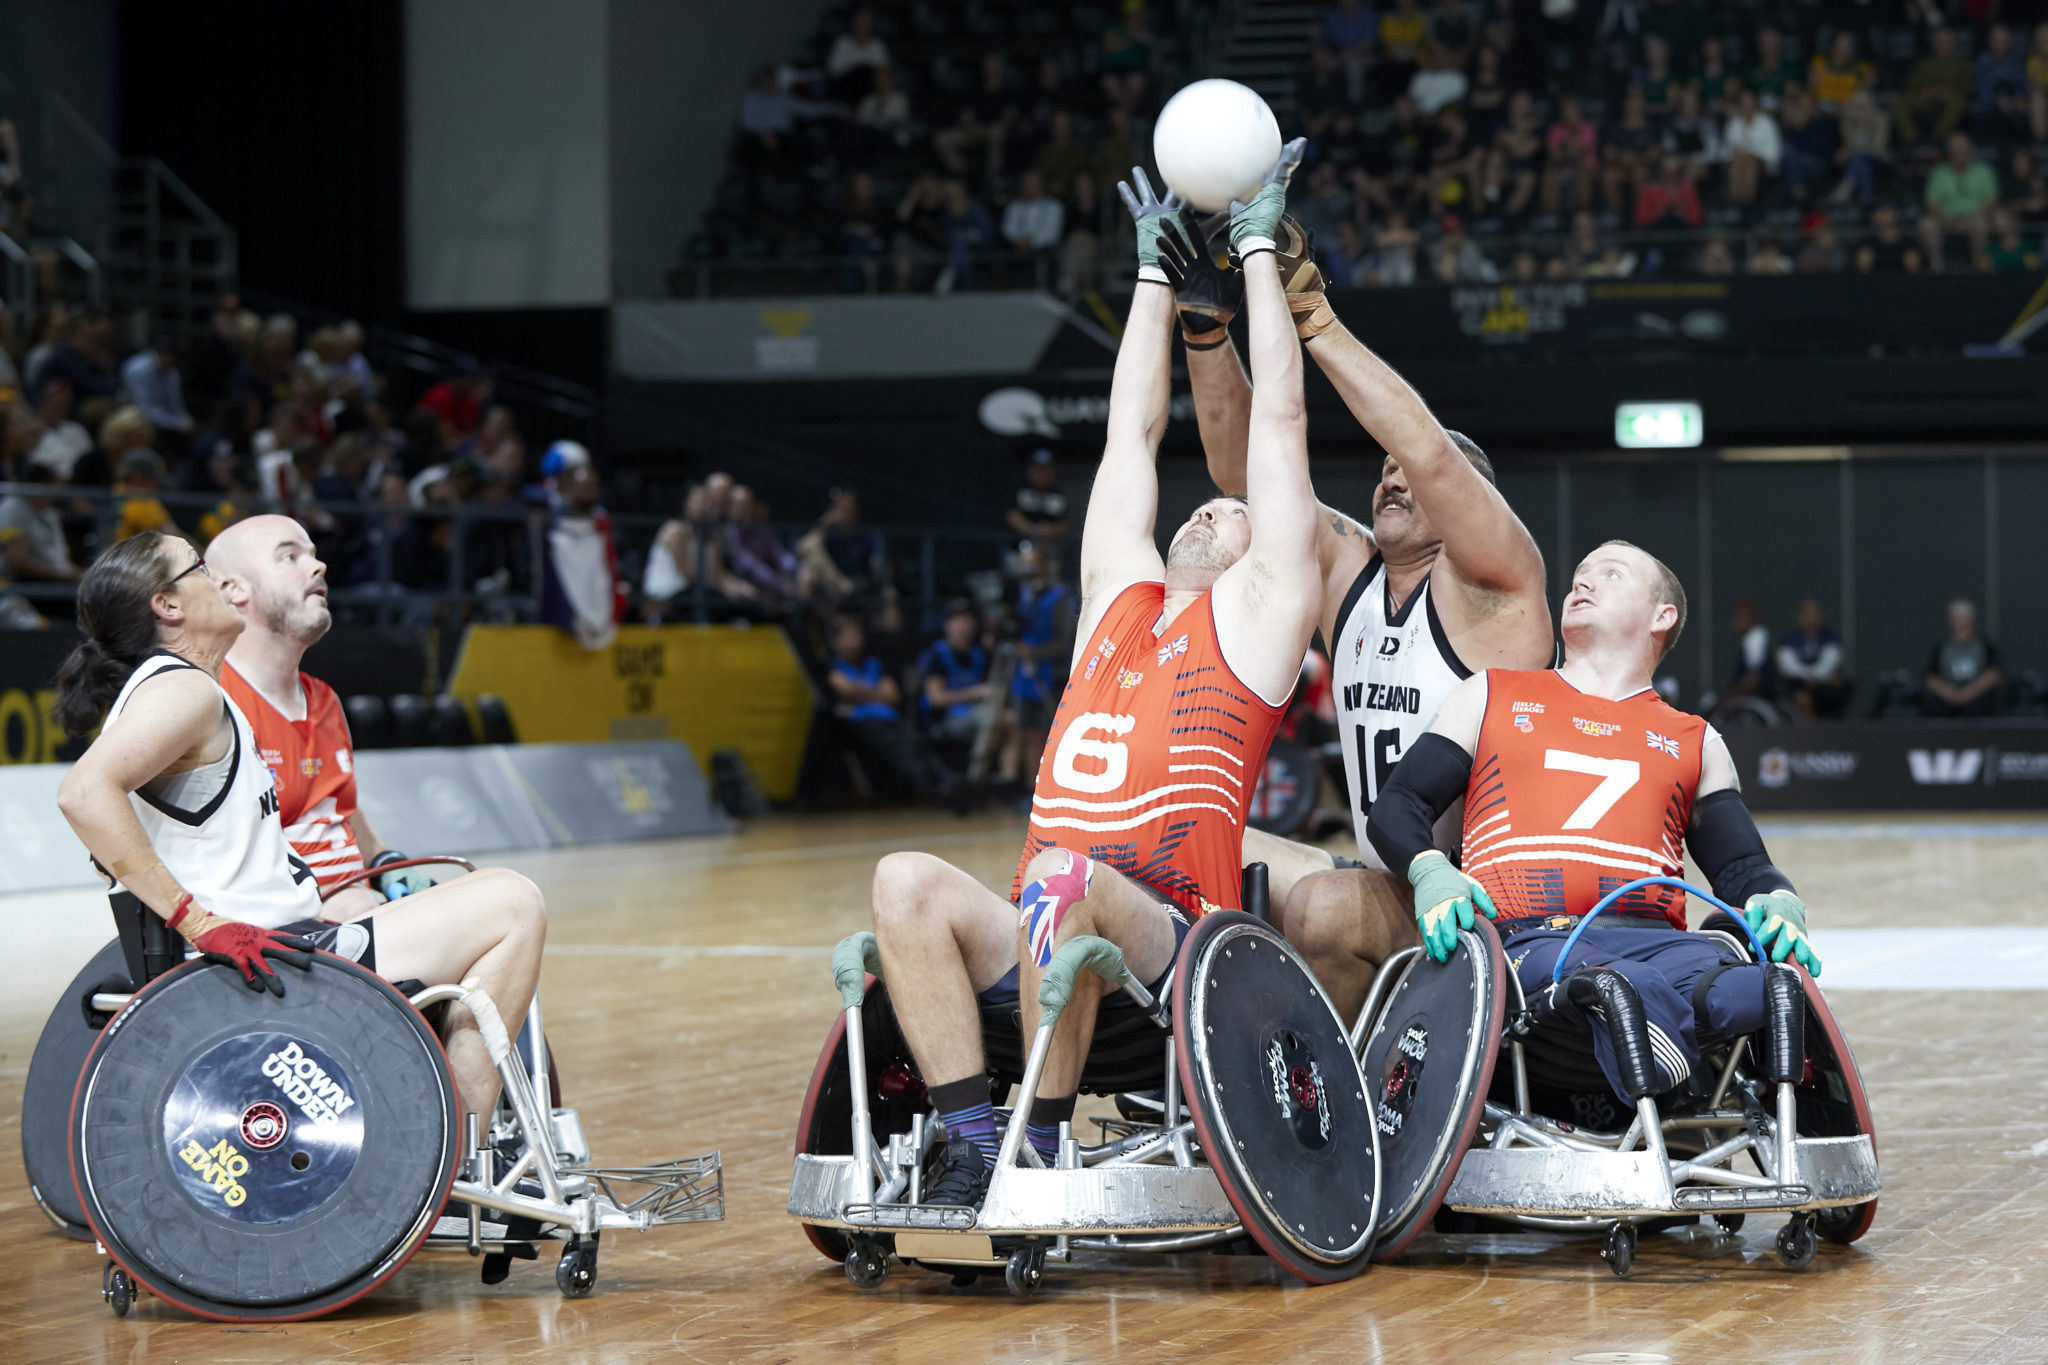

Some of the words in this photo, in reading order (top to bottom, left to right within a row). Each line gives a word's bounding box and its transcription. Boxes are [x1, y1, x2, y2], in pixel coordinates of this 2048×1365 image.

[1052, 711, 1136, 794] 6
[1572, 716, 1622, 732] INVICTUS
[1575, 723, 1613, 736] GAMES
[1543, 748, 1641, 830] 7
[278, 1041, 355, 1115] DOWN
[1271, 1038, 1291, 1119] ROMA
[1397, 1034, 1428, 1062] ROMA
[261, 1053, 341, 1130] UNDER
[178, 1139, 248, 1208] GAME
[208, 1138, 250, 1178] ON
